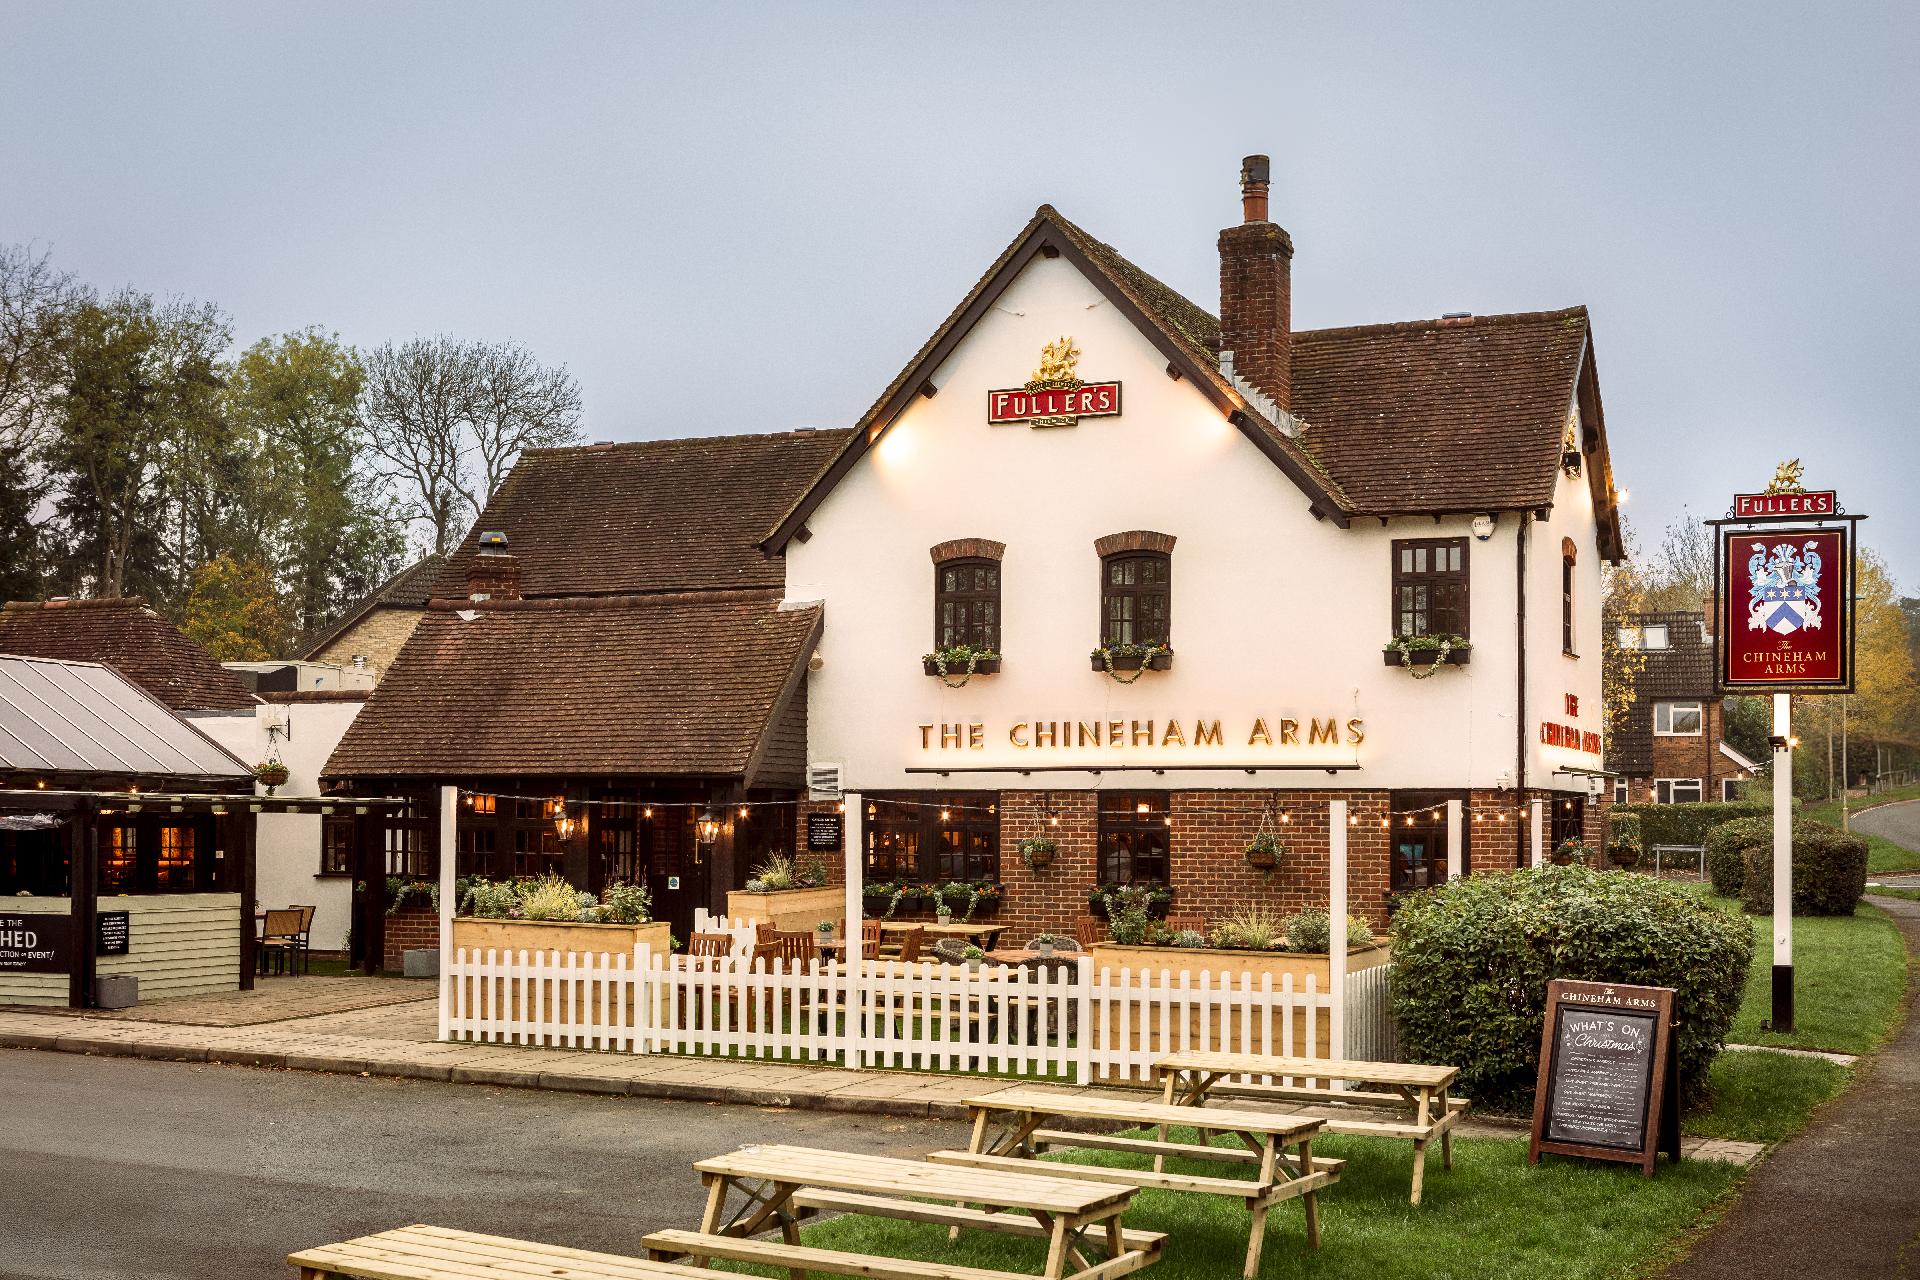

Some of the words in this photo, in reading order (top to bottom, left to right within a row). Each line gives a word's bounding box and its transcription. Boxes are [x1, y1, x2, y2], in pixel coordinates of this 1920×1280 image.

[997, 387, 1110, 416] FULLER'S
[1741, 495, 1827, 513] FULLER'S
[1776, 640, 1793, 651] The
[1743, 651, 1827, 663] CHINEHAM
[1764, 663, 1806, 674] ARMS
[918, 722, 984, 749] THE
[1009, 719, 1224, 748] CHINEHAM
[1247, 717, 1365, 746] ARMS
[6, 919, 23, 927] THE
[27, 950, 55, 961] EVENT!
[1561, 992, 1621, 1005] CHINEHAM
[1625, 997, 1656, 1008] ARMS
[1569, 1020, 1615, 1033] WHAT'S
[1621, 1024, 1641, 1039] ON
[1574, 1032, 1636, 1052] Christmas
